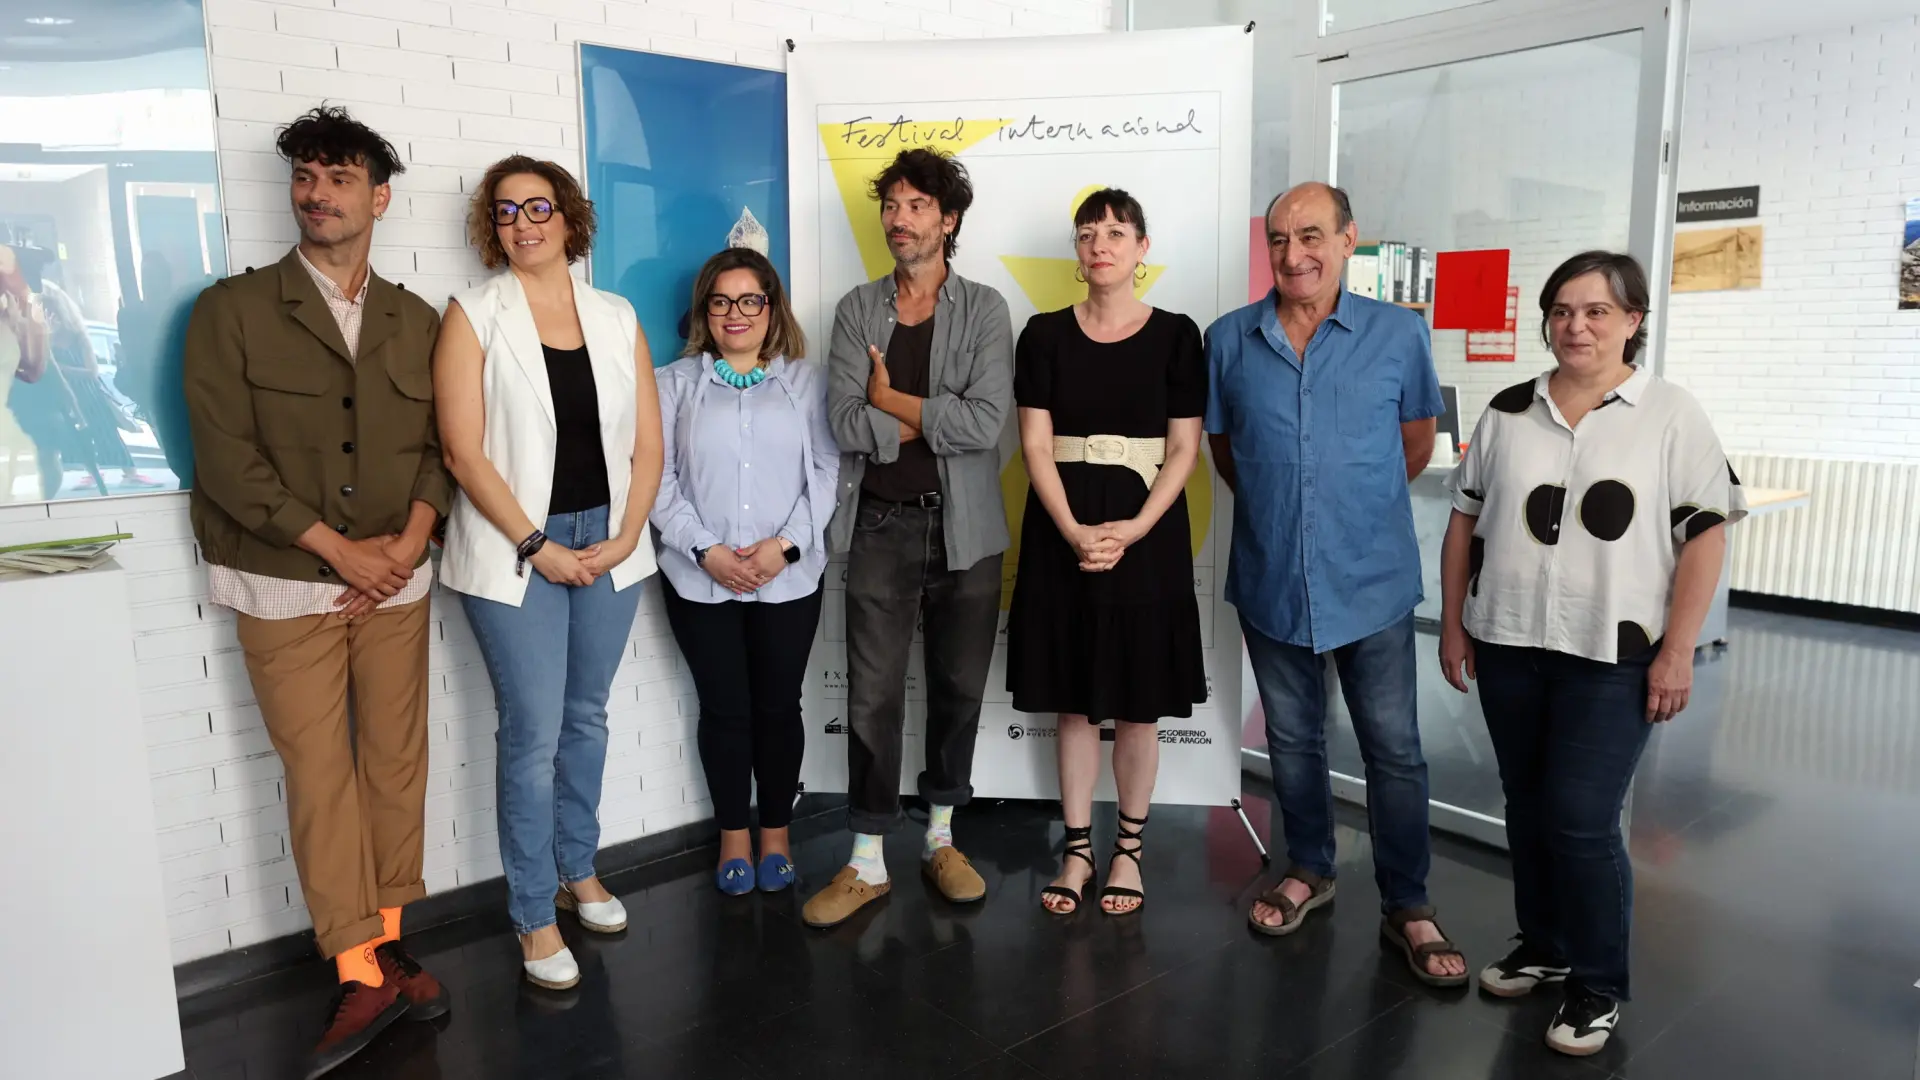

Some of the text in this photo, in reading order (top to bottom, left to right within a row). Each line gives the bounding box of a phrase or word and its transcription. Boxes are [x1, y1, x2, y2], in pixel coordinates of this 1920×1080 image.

[841, 114, 964, 148] Festival
[1678, 196, 1754, 213] Información
[1166, 729, 1206, 737] GOBIERNO
